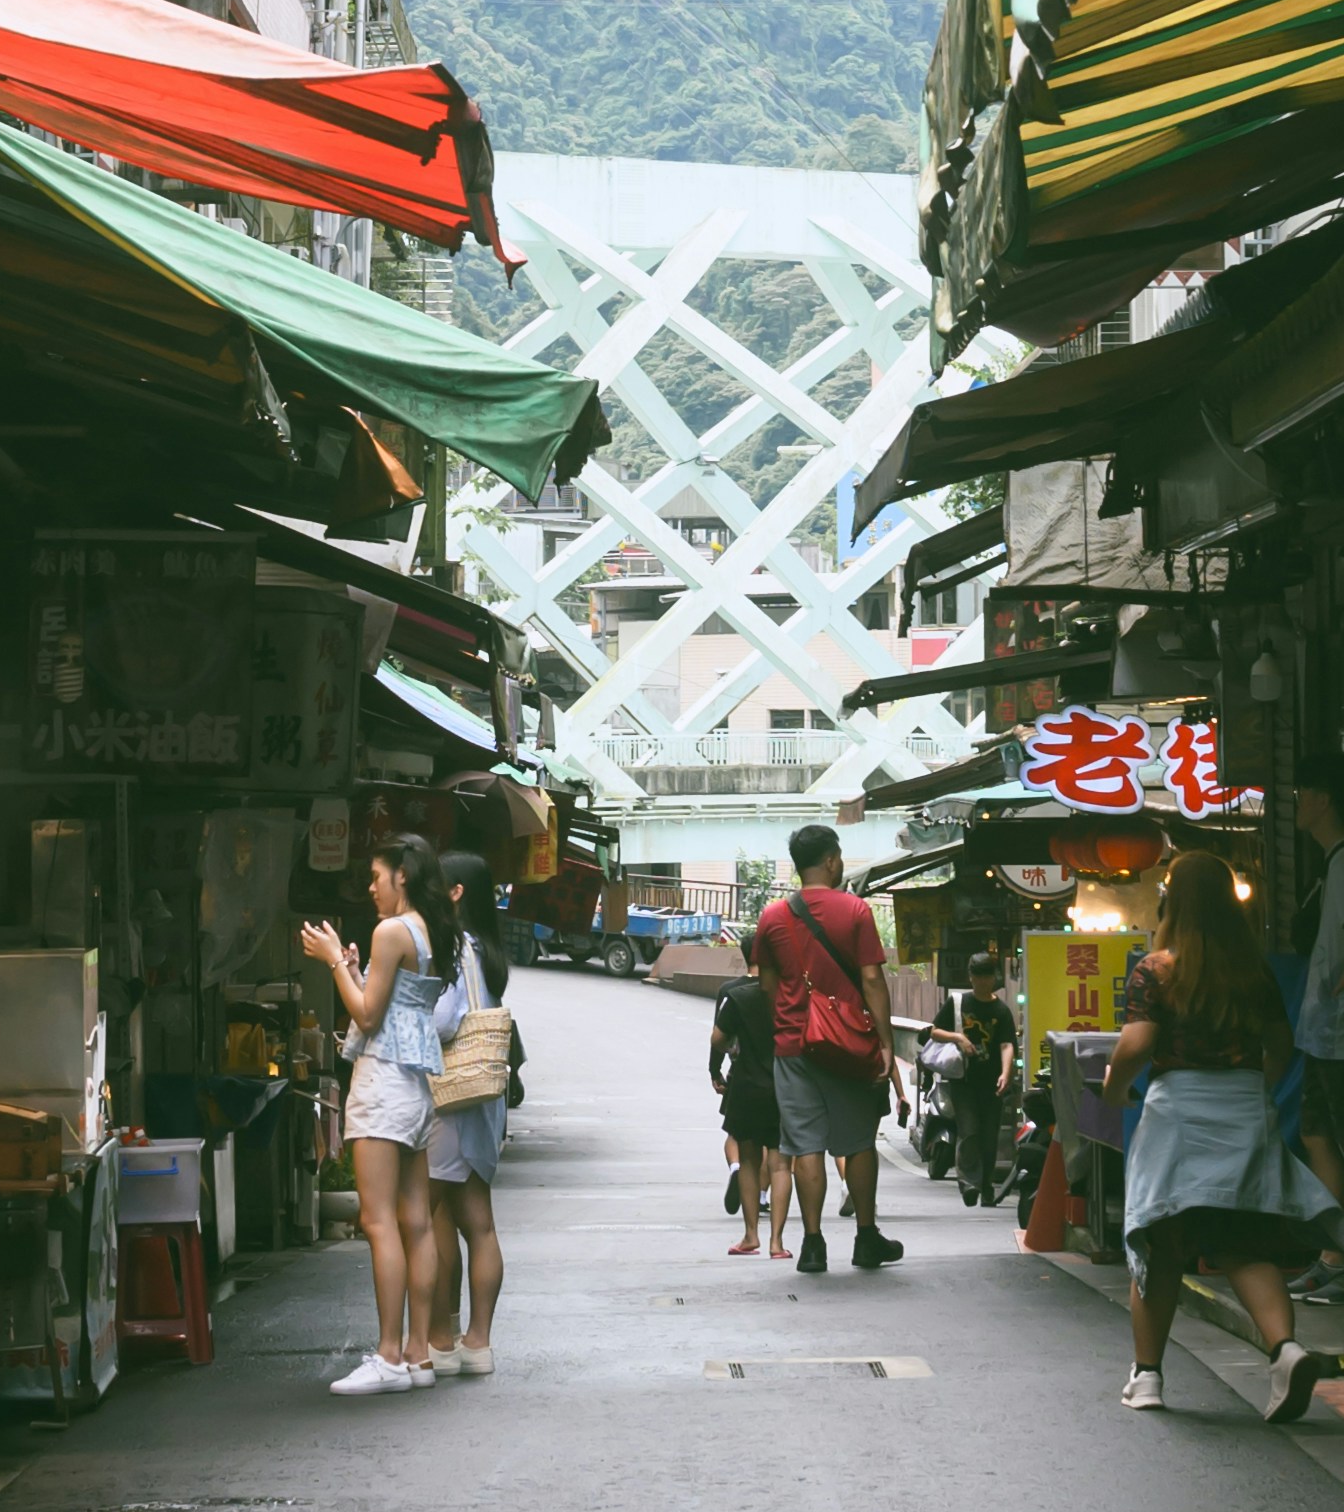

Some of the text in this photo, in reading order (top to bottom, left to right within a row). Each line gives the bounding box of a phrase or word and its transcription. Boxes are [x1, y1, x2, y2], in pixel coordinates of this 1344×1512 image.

[32, 708, 241, 764] 小米油飯
[313, 627, 347, 768] 燒仙草
